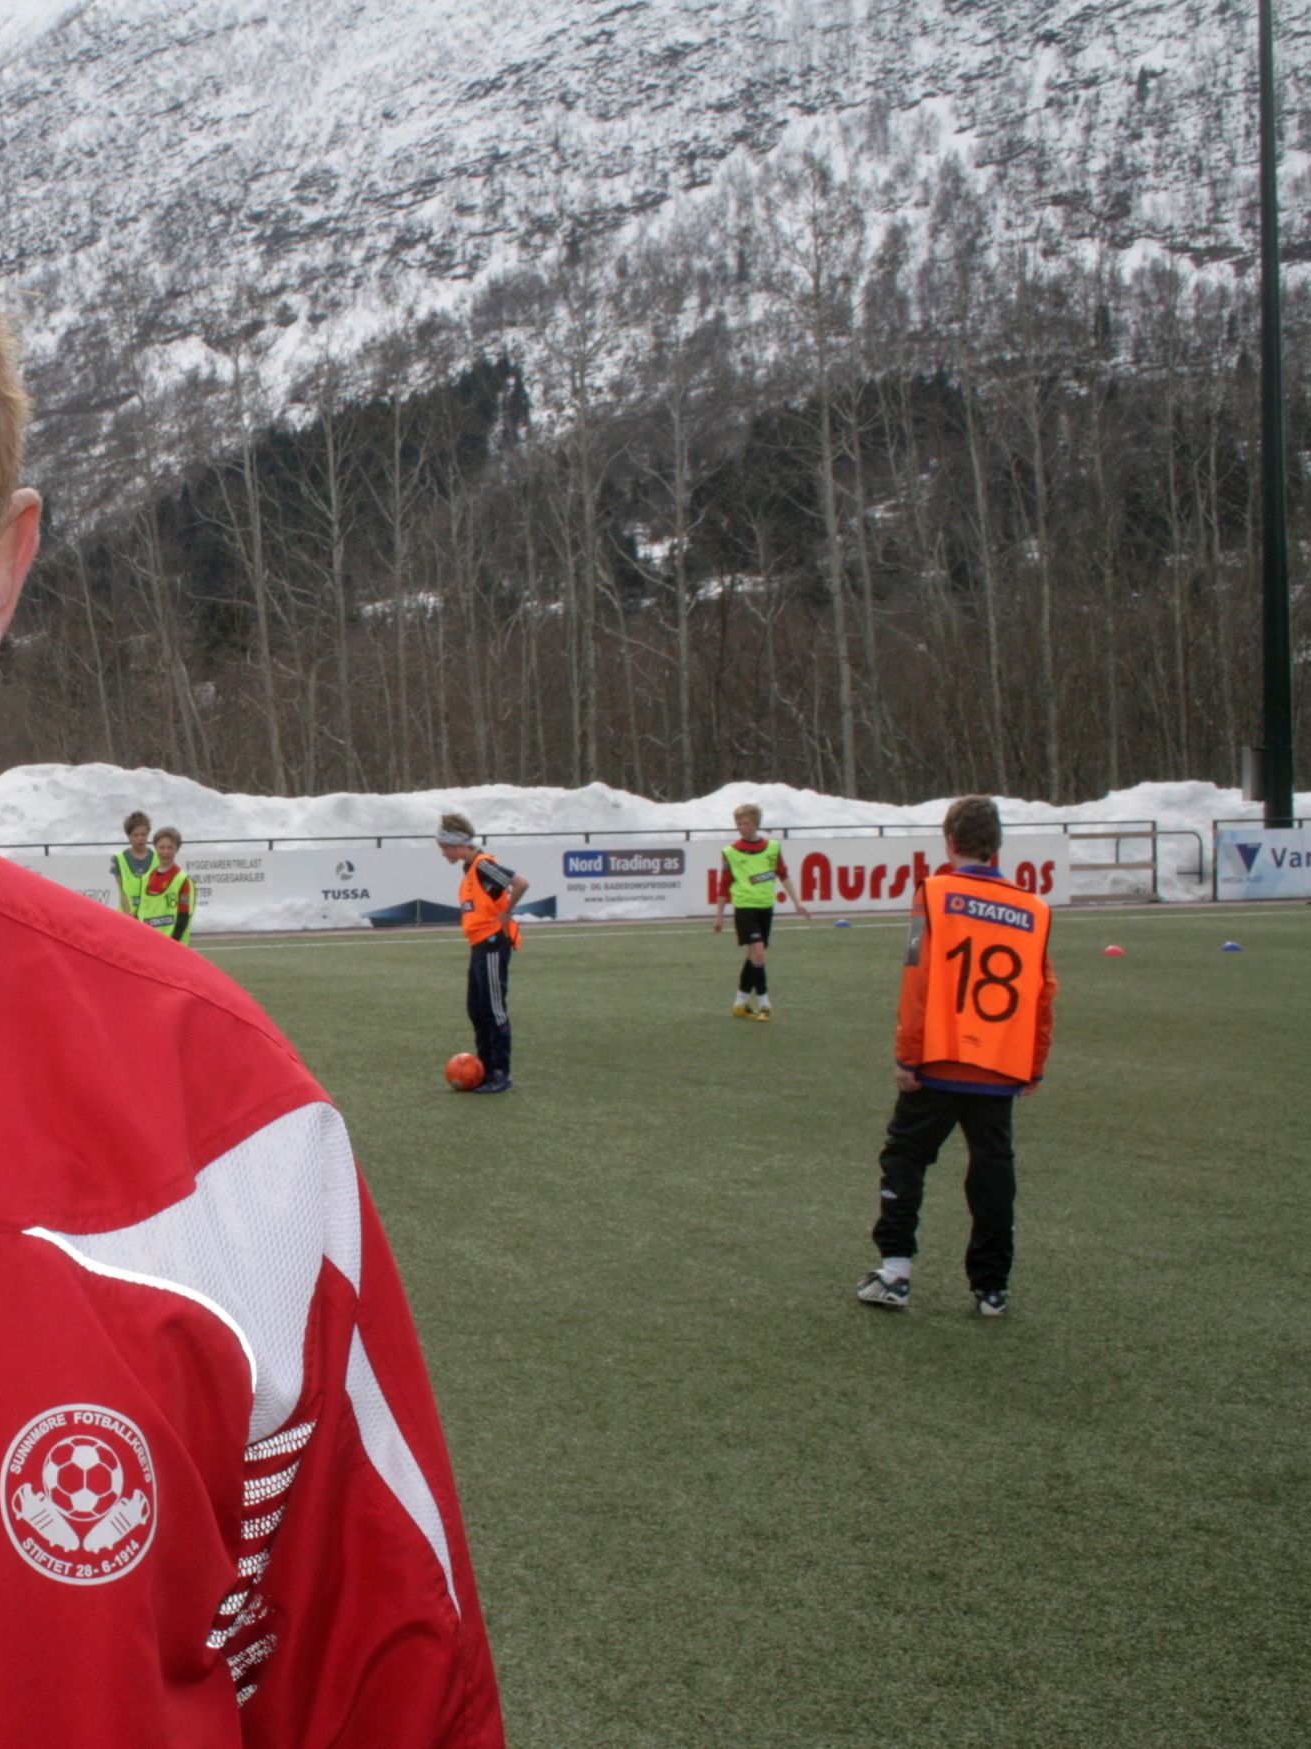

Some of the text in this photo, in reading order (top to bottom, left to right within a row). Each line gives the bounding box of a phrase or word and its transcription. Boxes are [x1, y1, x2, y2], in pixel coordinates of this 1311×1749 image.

[569, 854, 680, 874] Nord Trading as
[801, 852, 999, 901] Aurst
[1016, 860, 1055, 894] as
[321, 888, 371, 900] TUSSA
[590, 882, 602, 891] OG
[164, 893, 177, 909] 18
[967, 902, 1031, 928] STATOIL
[946, 937, 1023, 1022] 18
[10, 1412, 152, 1483] SUNNMØRE FOTBALLKRETS
[22, 1537, 73, 1575] STIFTET
